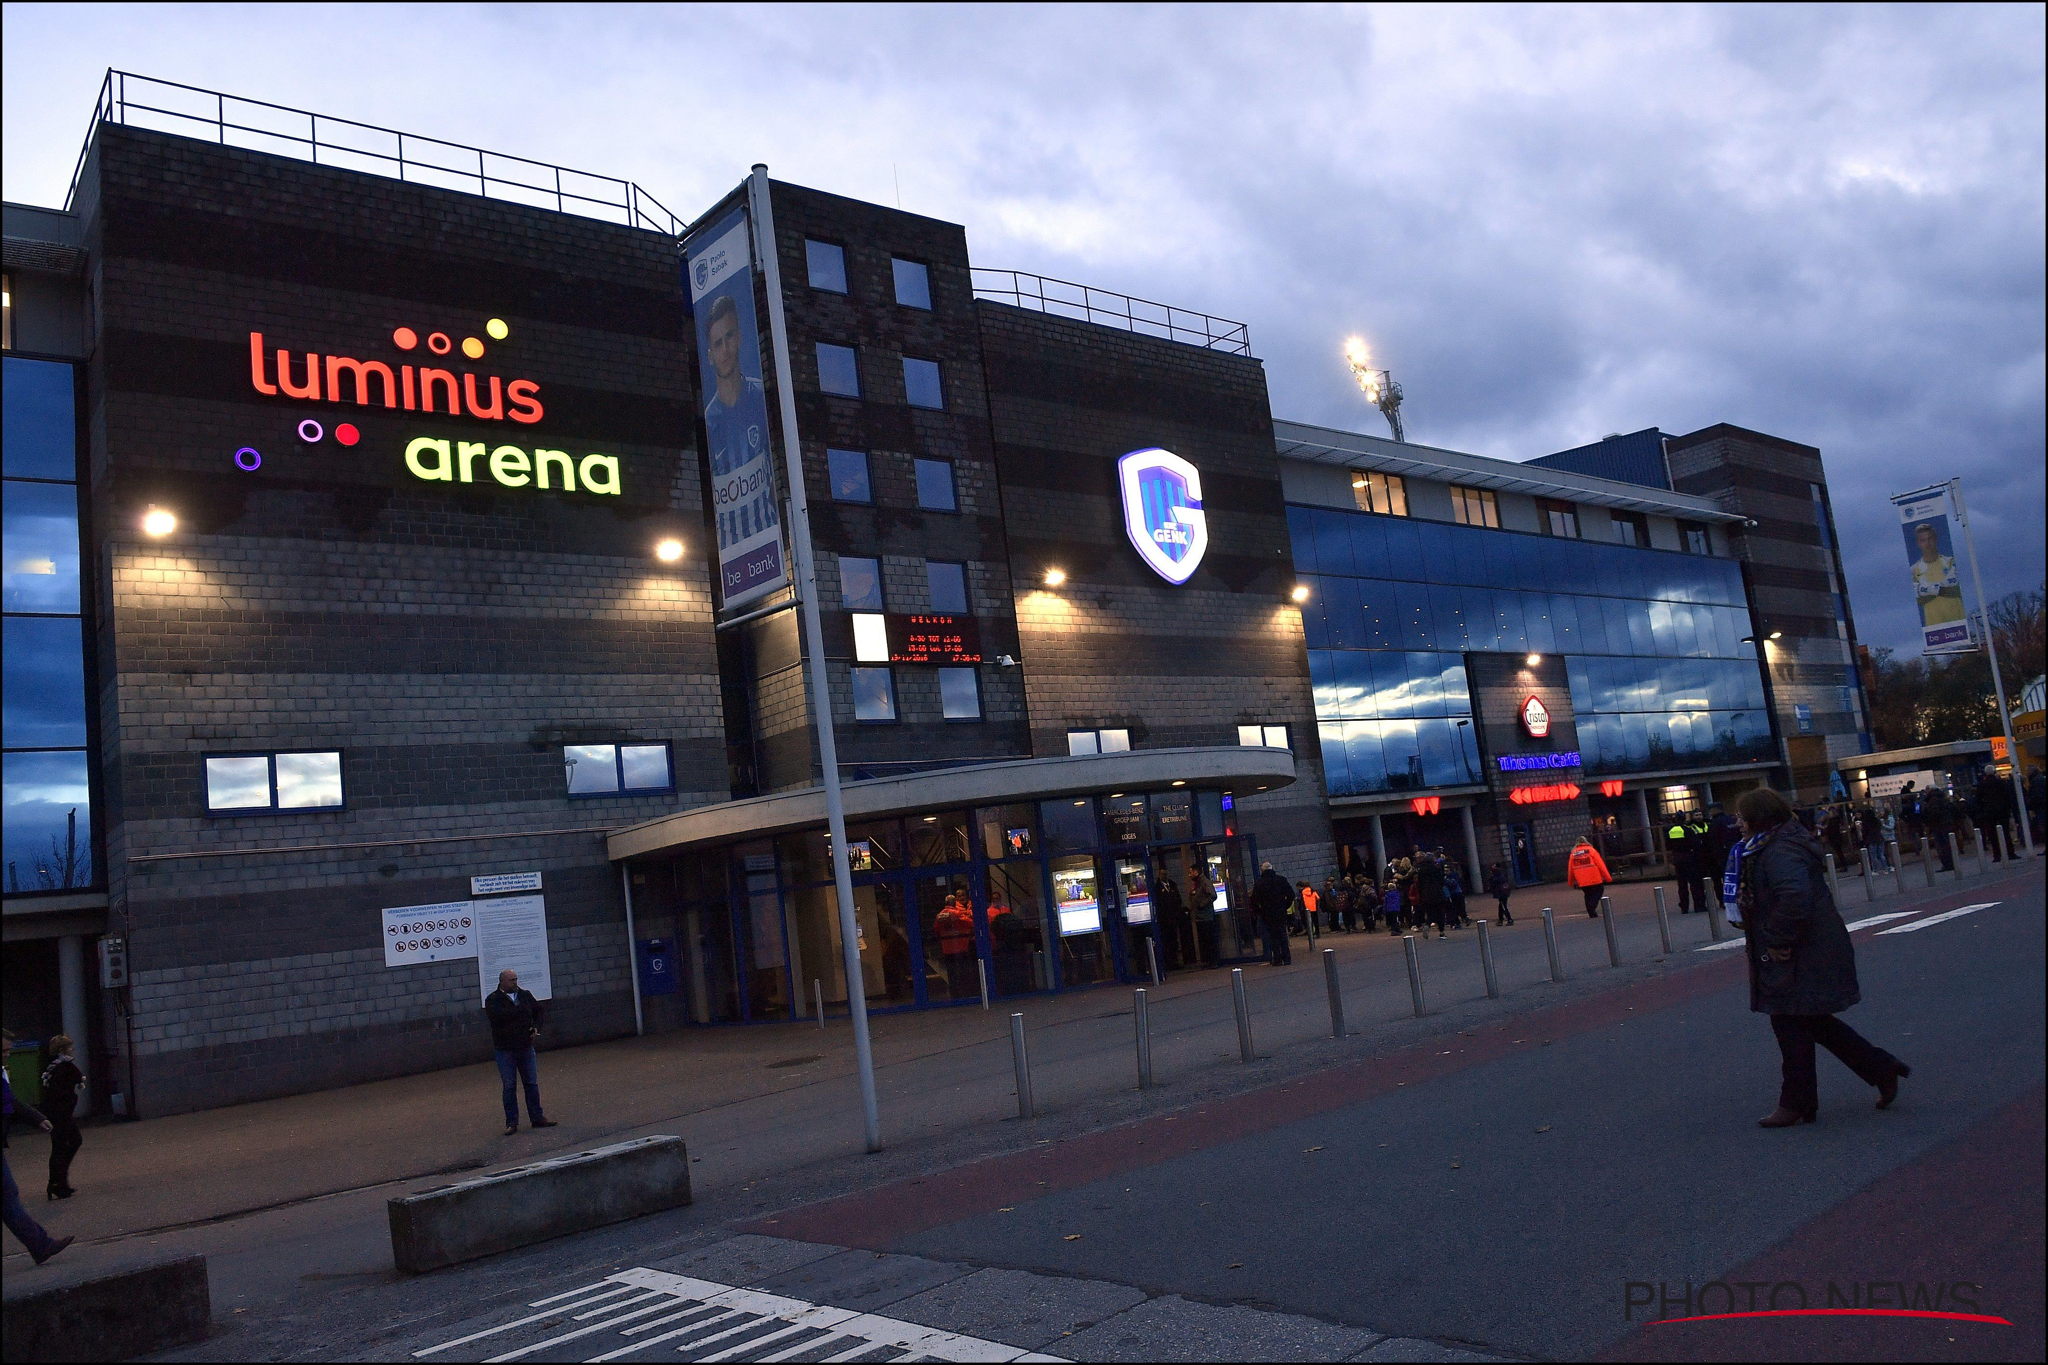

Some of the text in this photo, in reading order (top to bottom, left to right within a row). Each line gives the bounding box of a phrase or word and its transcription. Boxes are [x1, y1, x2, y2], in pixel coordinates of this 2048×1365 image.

[250, 332, 544, 424] luminus
[405, 436, 621, 495] arena
[1154, 528, 1188, 545] GENK
